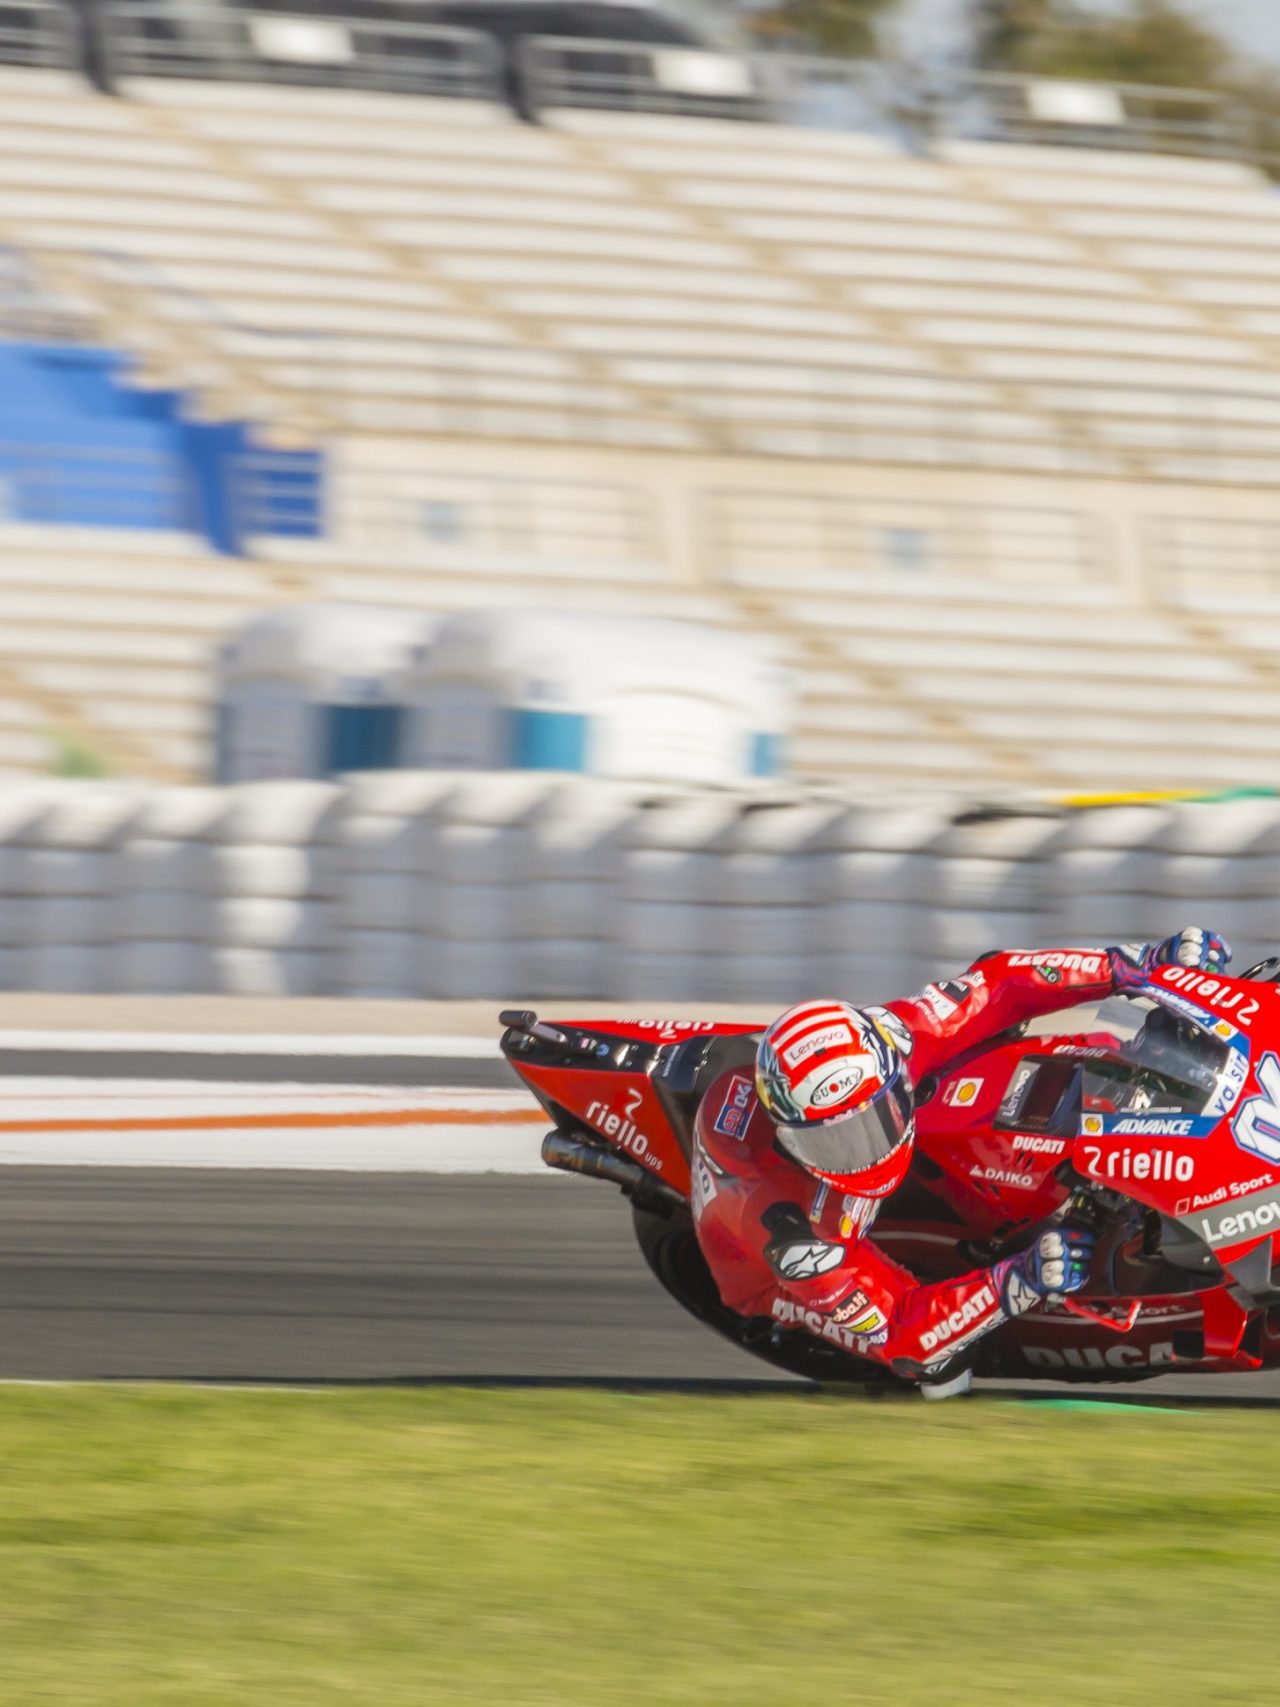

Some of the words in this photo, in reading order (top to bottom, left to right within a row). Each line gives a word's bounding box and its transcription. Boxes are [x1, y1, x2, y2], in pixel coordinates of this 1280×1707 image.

[1007, 952, 1102, 974] DUCATI
[1162, 967, 1245, 1008] riello
[789, 1030, 844, 1061] Lenovo
[1002, 1069, 1031, 1117] Lenovo
[586, 1101, 648, 1155] riello
[1111, 1119, 1194, 1135] ADVANCE
[1012, 1135, 1065, 1154] DUCATI
[985, 1167, 1033, 1186] DAIKO
[1108, 1148, 1195, 1181] riello
[1192, 1186, 1228, 1208] Audi
[1230, 1173, 1274, 1196] Sport
[920, 1286, 996, 1352] DUCATI
